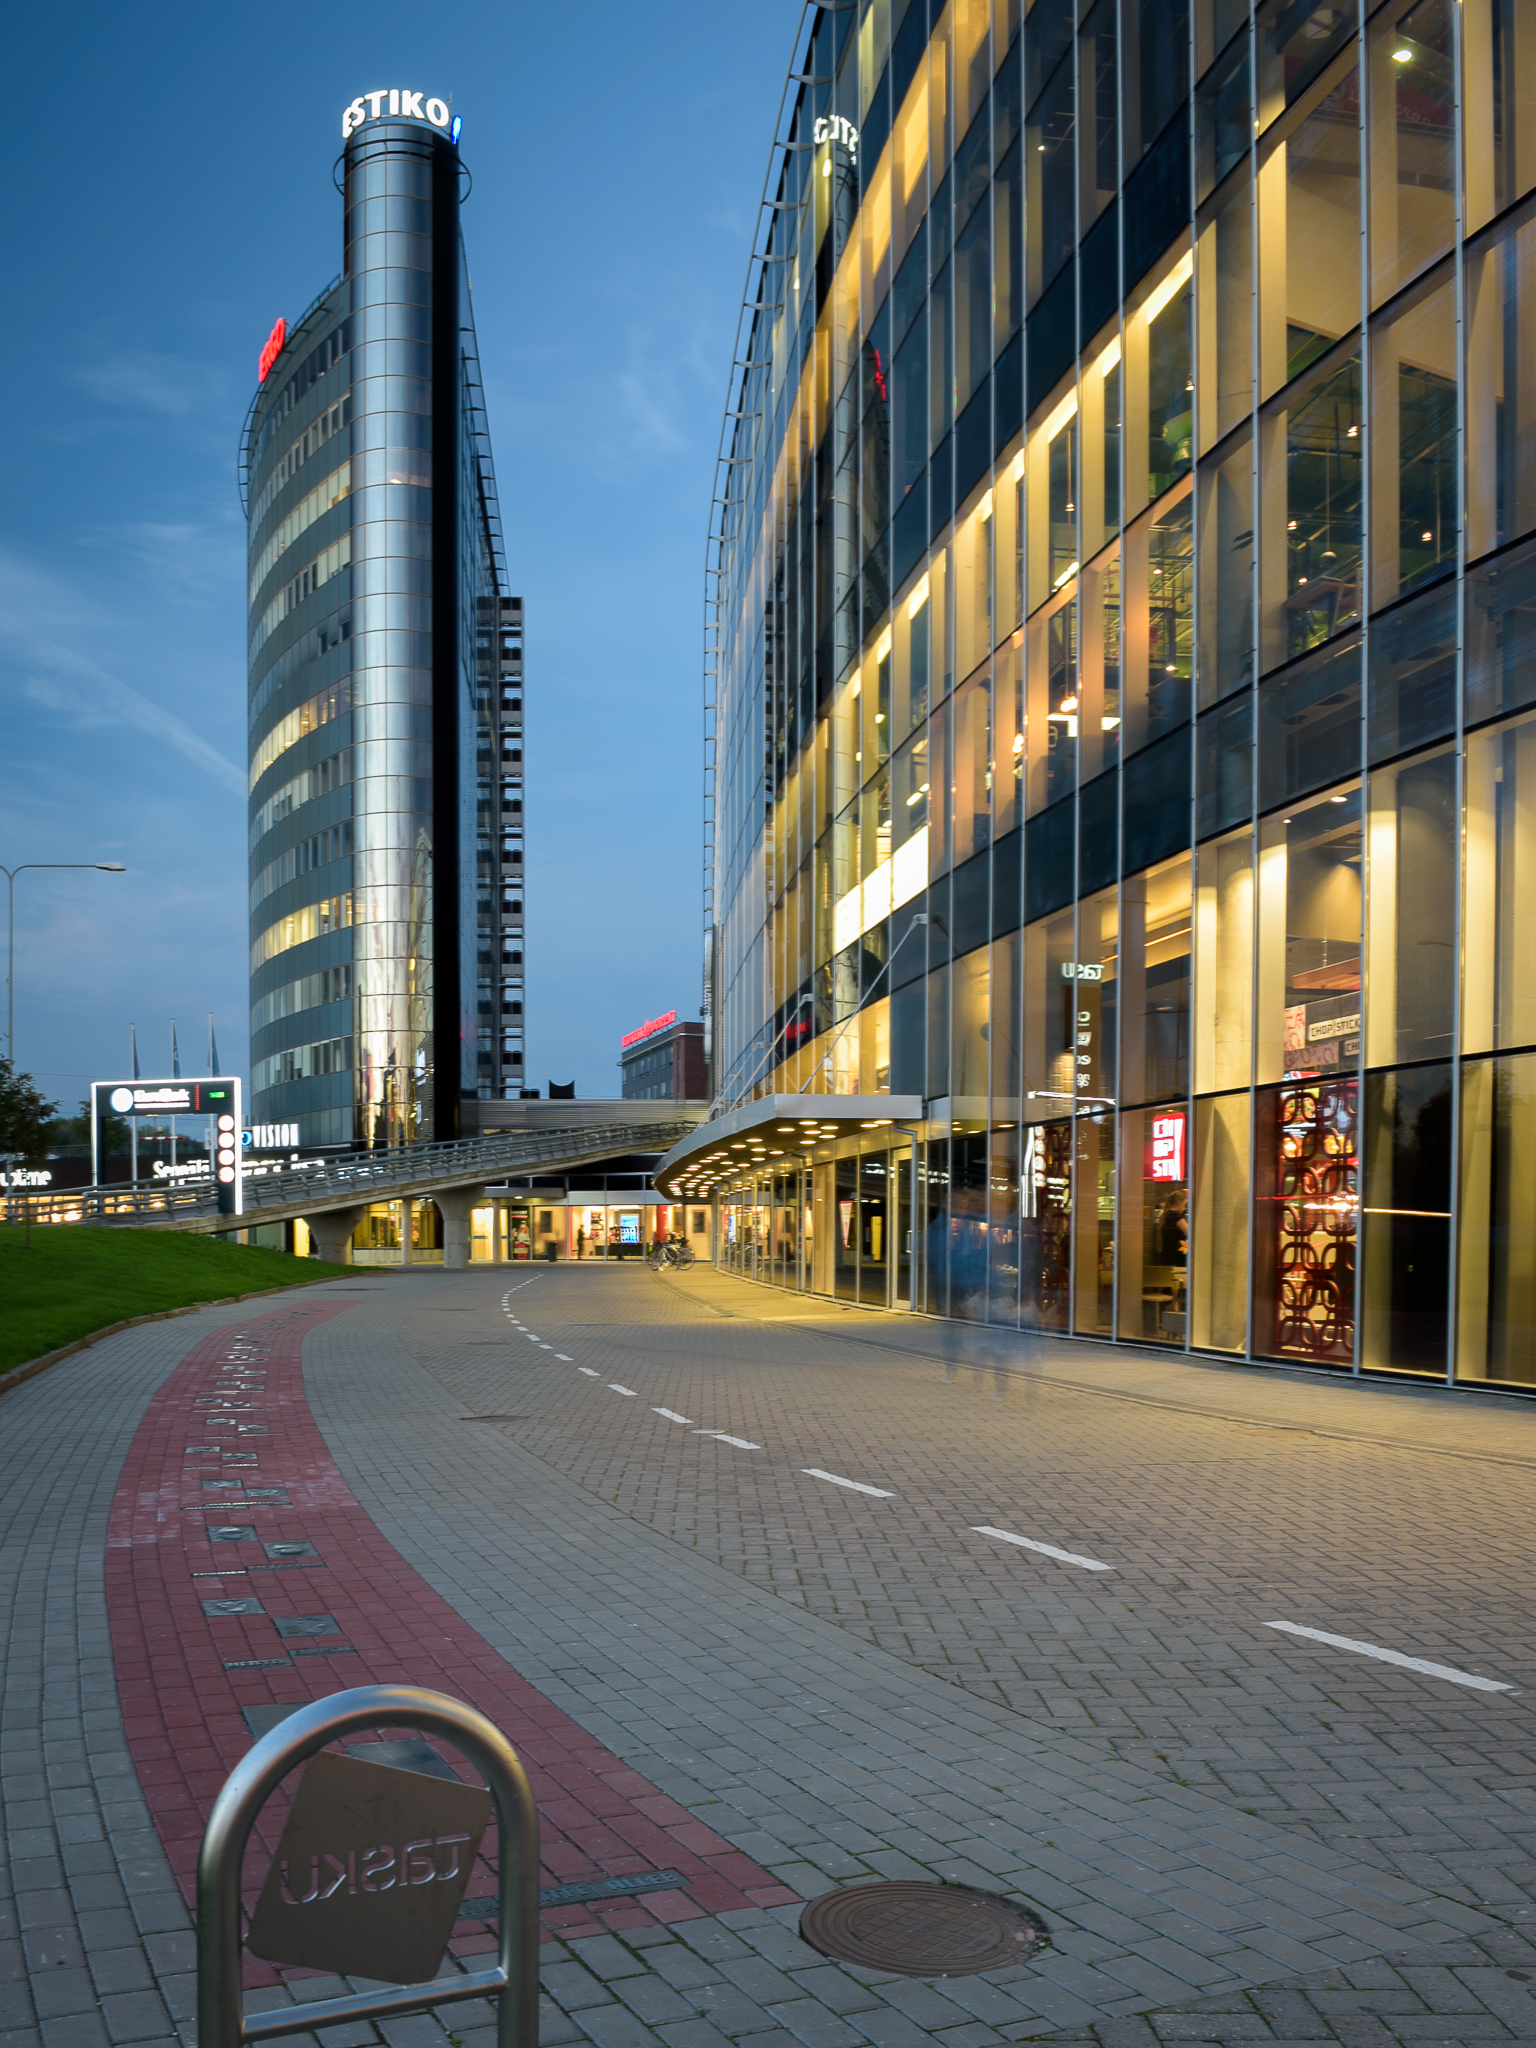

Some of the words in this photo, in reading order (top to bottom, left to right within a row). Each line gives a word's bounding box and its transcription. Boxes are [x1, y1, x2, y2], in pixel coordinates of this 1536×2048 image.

[1311, 1024, 1333, 1037] CHOP
[253, 1123, 299, 1147] VISION
[606, 1872, 678, 1892] ALLEE
